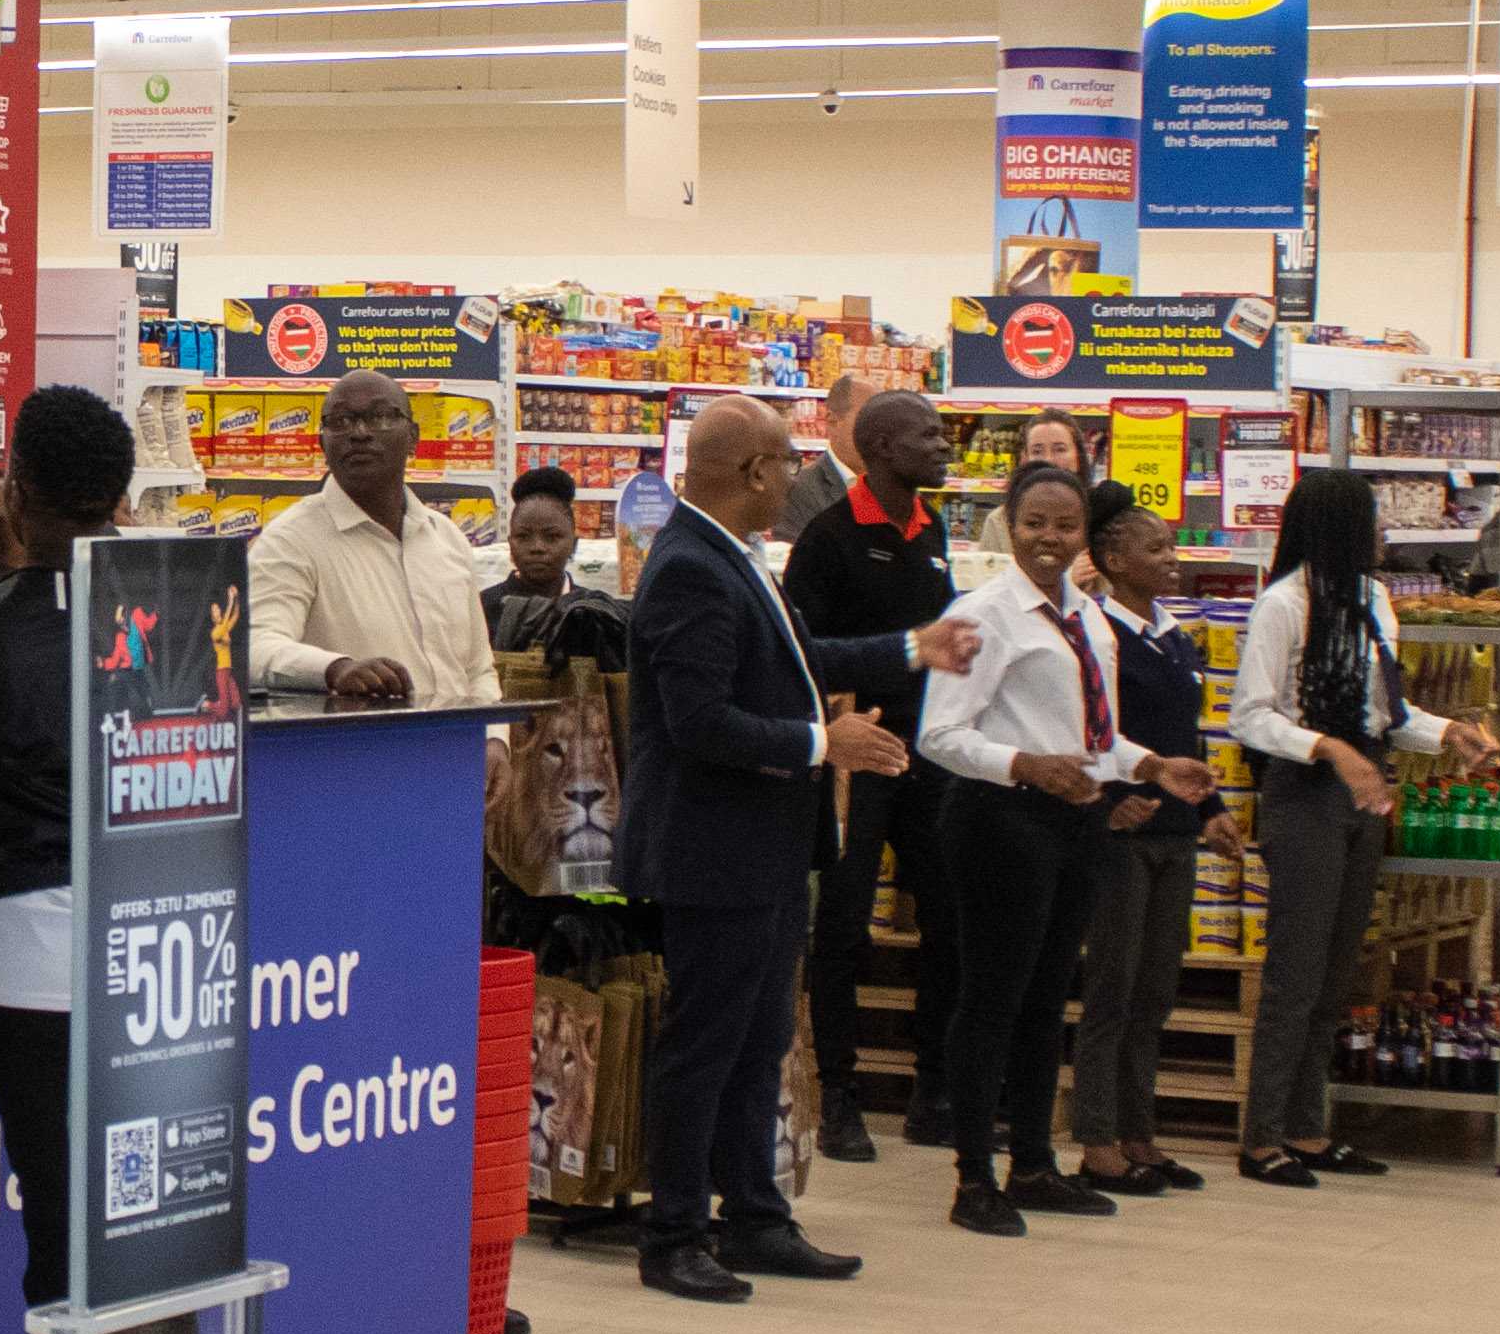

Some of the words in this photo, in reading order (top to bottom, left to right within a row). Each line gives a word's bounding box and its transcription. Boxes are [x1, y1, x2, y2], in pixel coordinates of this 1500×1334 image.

[1167, 44, 1185, 56] To
[1207, 43, 1276, 58] Shoppers:
[1050, 78, 1115, 92] Carrefour
[1069, 95, 1114, 108] market
[1178, 102, 1204, 114] and
[1207, 102, 1265, 116] smoking
[108, 107, 161, 116] FRESHNESS
[162, 105, 214, 116] GUARANTEE
[1167, 119, 1191, 131] not
[1193, 118, 1246, 131] allowed
[1248, 118, 1289, 131] inside
[1164, 136, 1186, 148] the
[1188, 135, 1278, 150] Supermarket
[1006, 145, 1038, 164] BIG
[1043, 145, 1132, 167] CHANGE
[1006, 167, 1042, 180] HUGE
[1044, 166, 1131, 183] DIFFERENCE
[341, 306, 387, 318] Carrefour
[388, 307, 415, 317] cares
[416, 305, 430, 317] for
[1092, 303, 1155, 317] Carrefour
[337, 326, 356, 338] We
[357, 326, 400, 339] tighten
[421, 326, 456, 339] prices
[1092, 325, 1162, 340] Tunakaza
[1163, 324, 1186, 338] bei
[1189, 325, 1222, 338] zetu
[1096, 342, 1180, 357] usilazimike
[1182, 343, 1234, 358] kukaza
[359, 357, 400, 371] tighten
[1106, 362, 1165, 376] mkanda
[1167, 362, 1207, 377] wako
[112, 722, 236, 758] CARREFOUR
[111, 756, 236, 814] FRIDAY
[110, 900, 152, 920] OFFERS
[154, 896, 182, 915] ZETU
[199, 979, 237, 1029] OFF
[290, 1056, 457, 1153] Centre
[202, 1125, 227, 1141] Store
